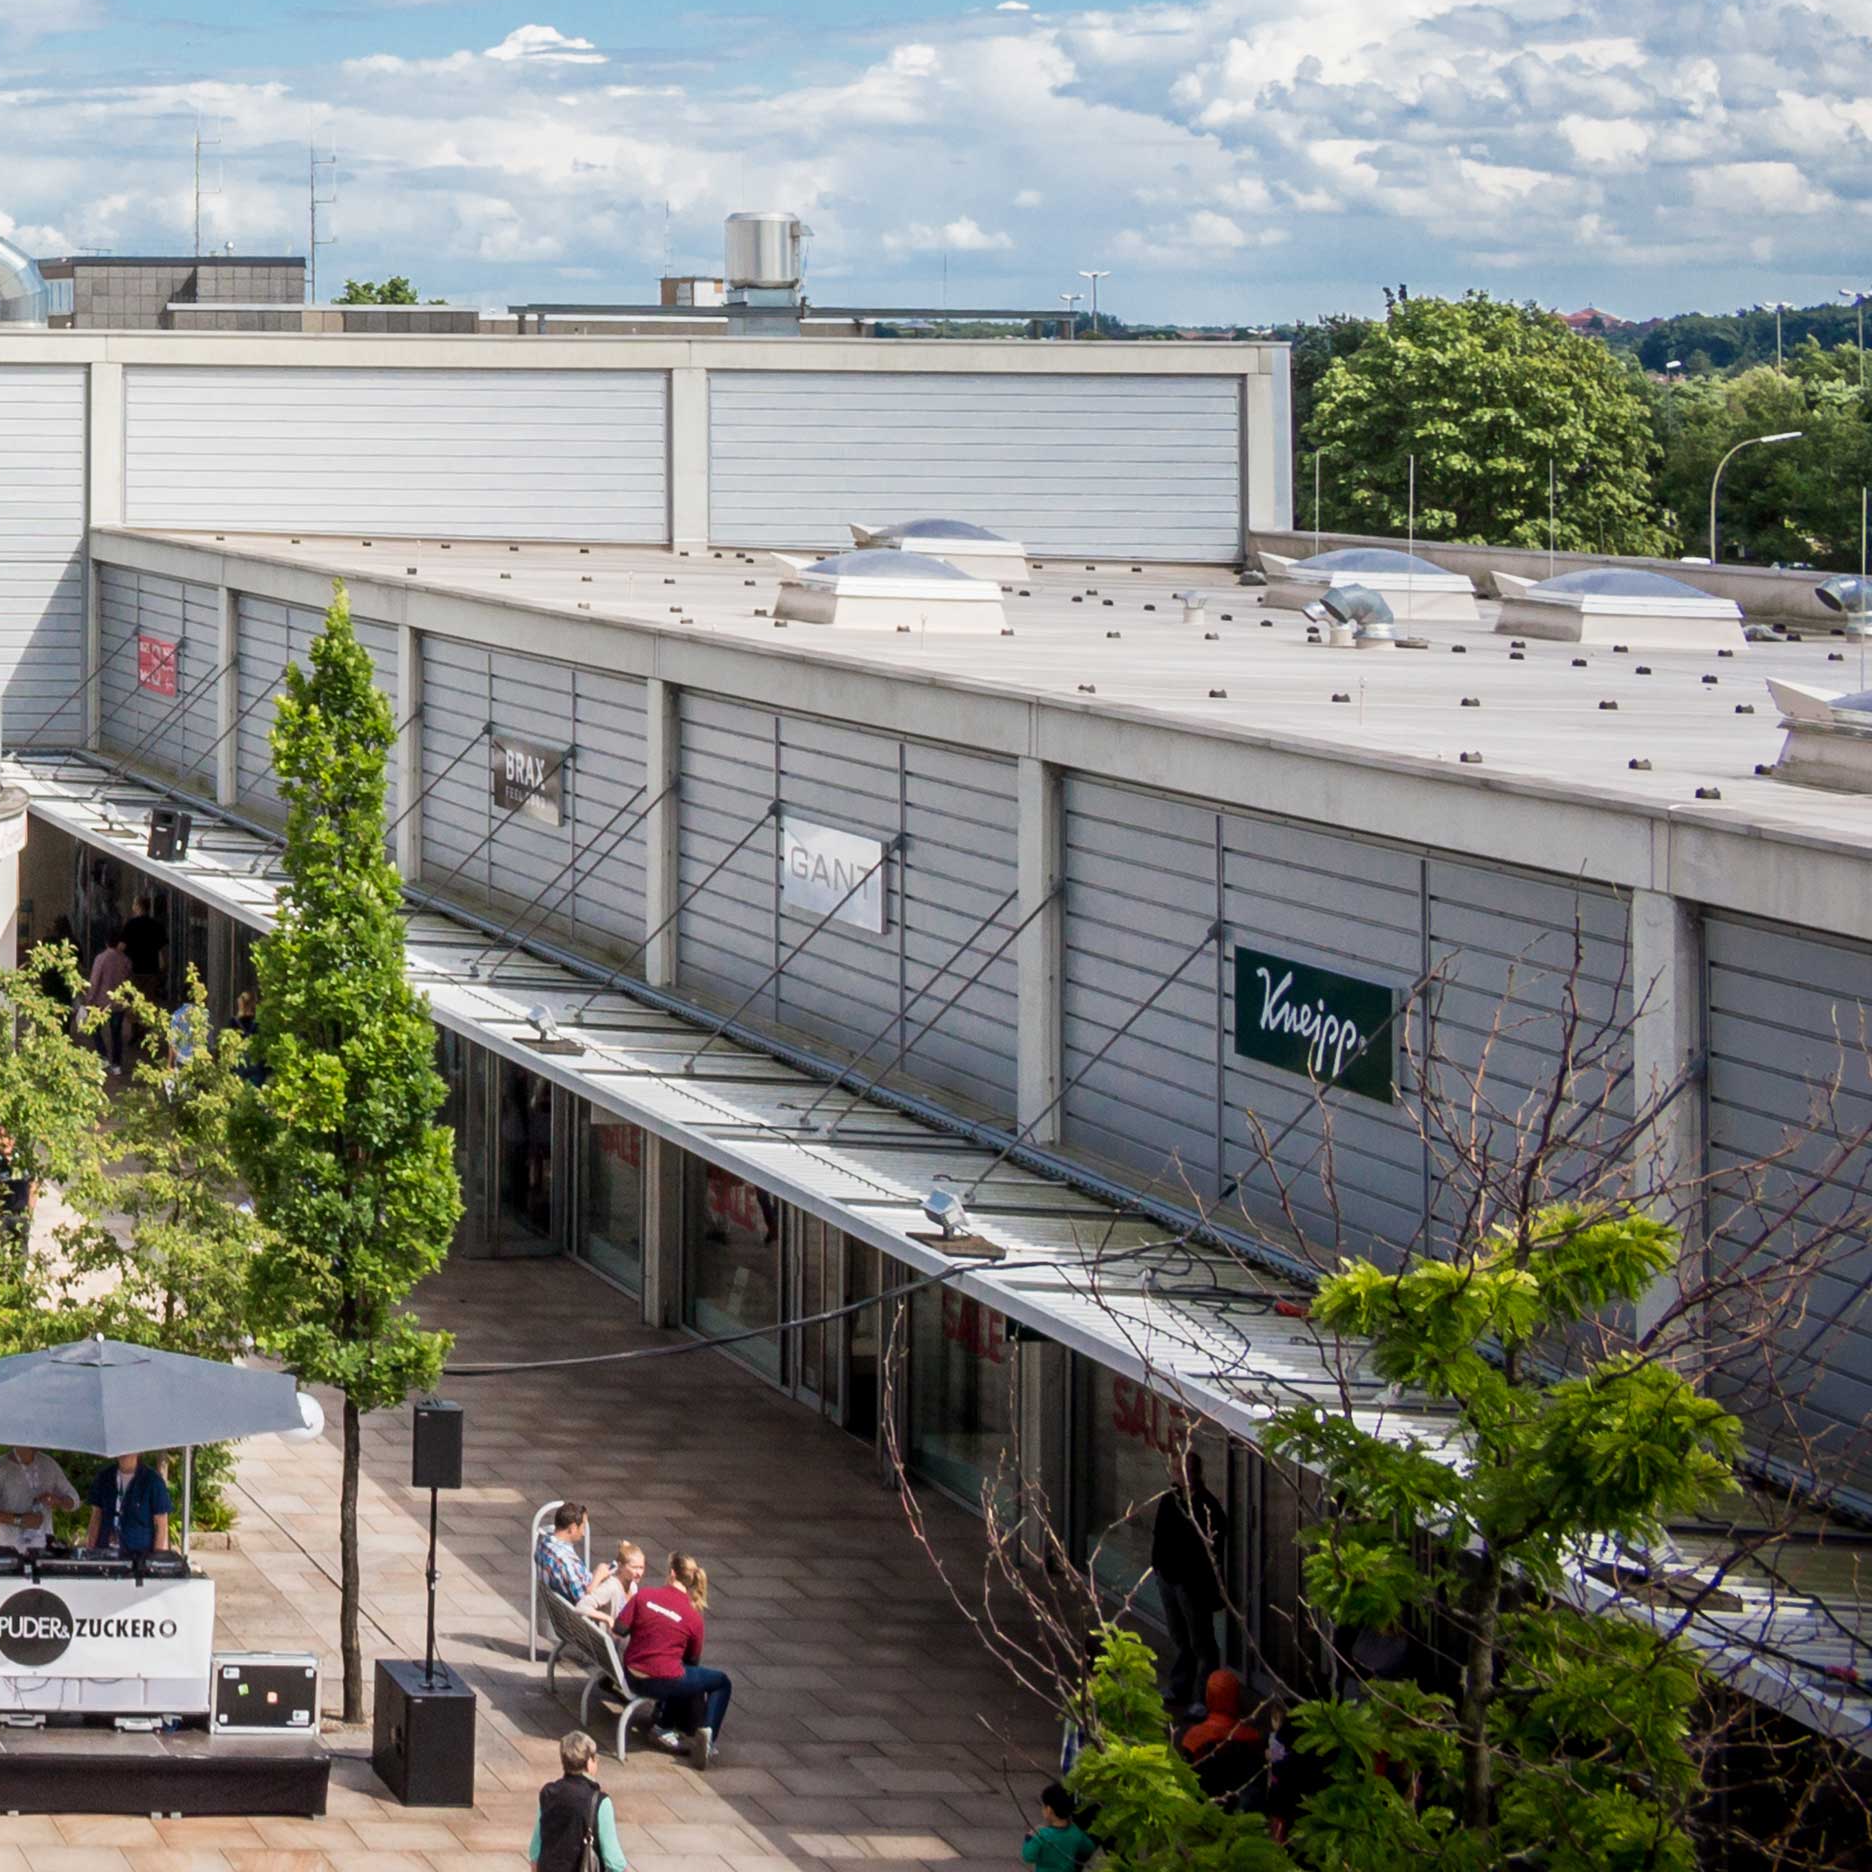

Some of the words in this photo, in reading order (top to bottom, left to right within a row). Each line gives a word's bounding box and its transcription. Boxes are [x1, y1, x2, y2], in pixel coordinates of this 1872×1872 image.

[506, 748, 546, 791] BRAX
[791, 846, 874, 901] GANT
[1256, 967, 1357, 1078] Kneipp
[76, 1618, 156, 1639] ZUCKER
